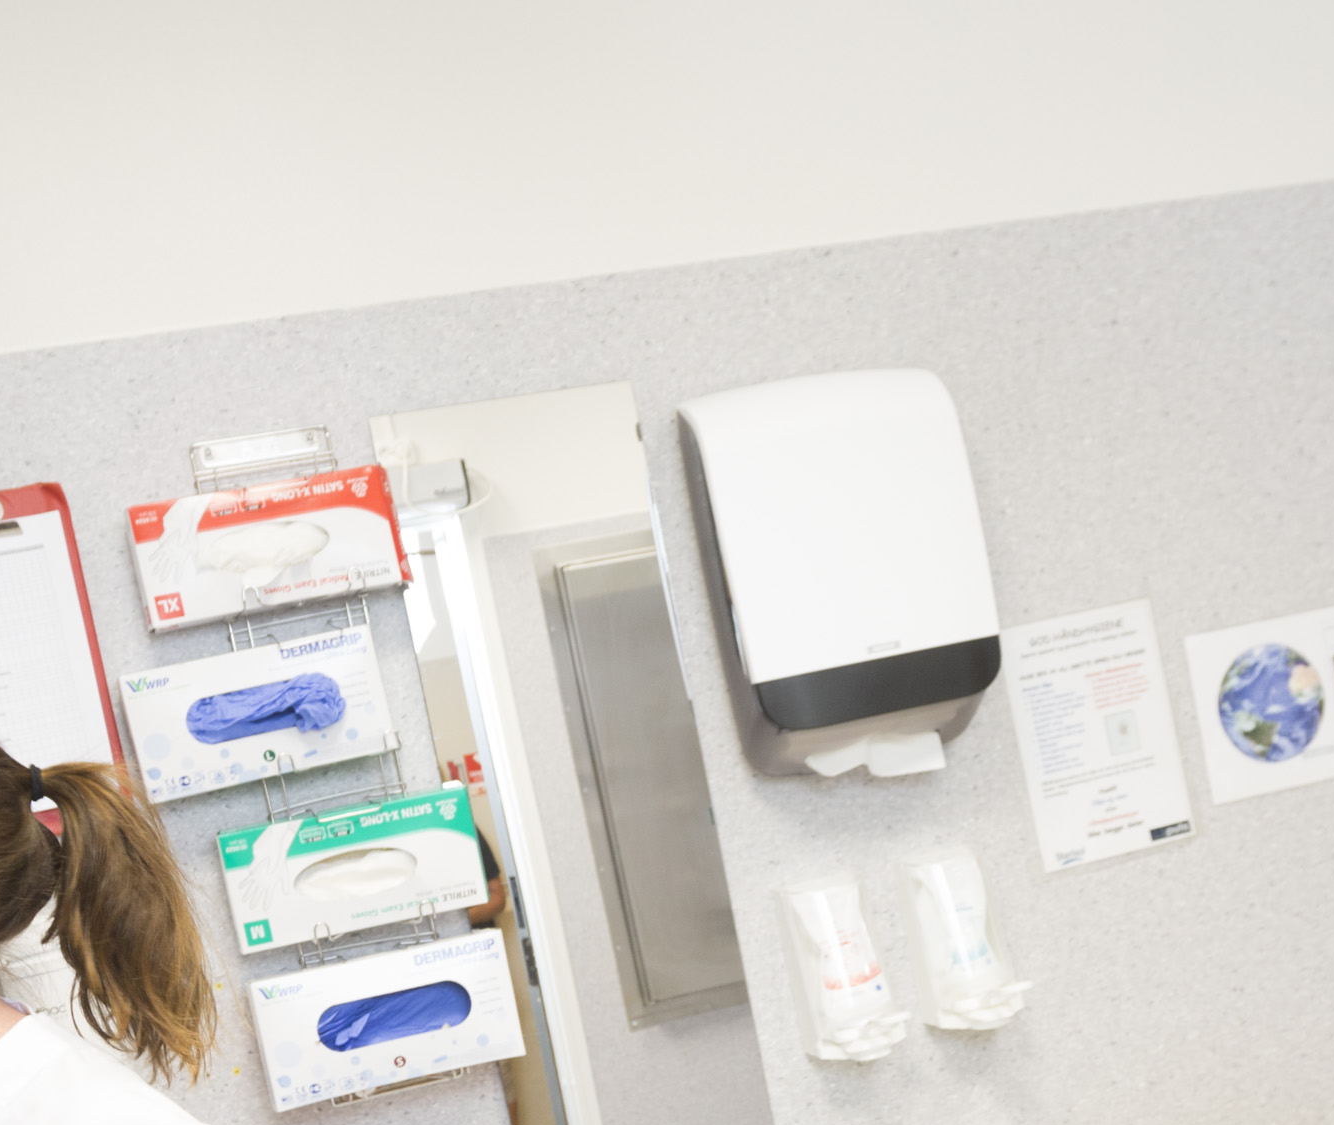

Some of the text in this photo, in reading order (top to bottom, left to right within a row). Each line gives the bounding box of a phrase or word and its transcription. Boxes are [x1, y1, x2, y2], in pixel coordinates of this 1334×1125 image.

[157, 597, 180, 613] XL
[280, 632, 363, 661] DERMAGRIP
[146, 677, 170, 690] WRP
[401, 802, 433, 820] SATIN
[250, 924, 266, 940] M
[413, 938, 495, 967] DERMAGRIP
[278, 983, 303, 996] WRP
